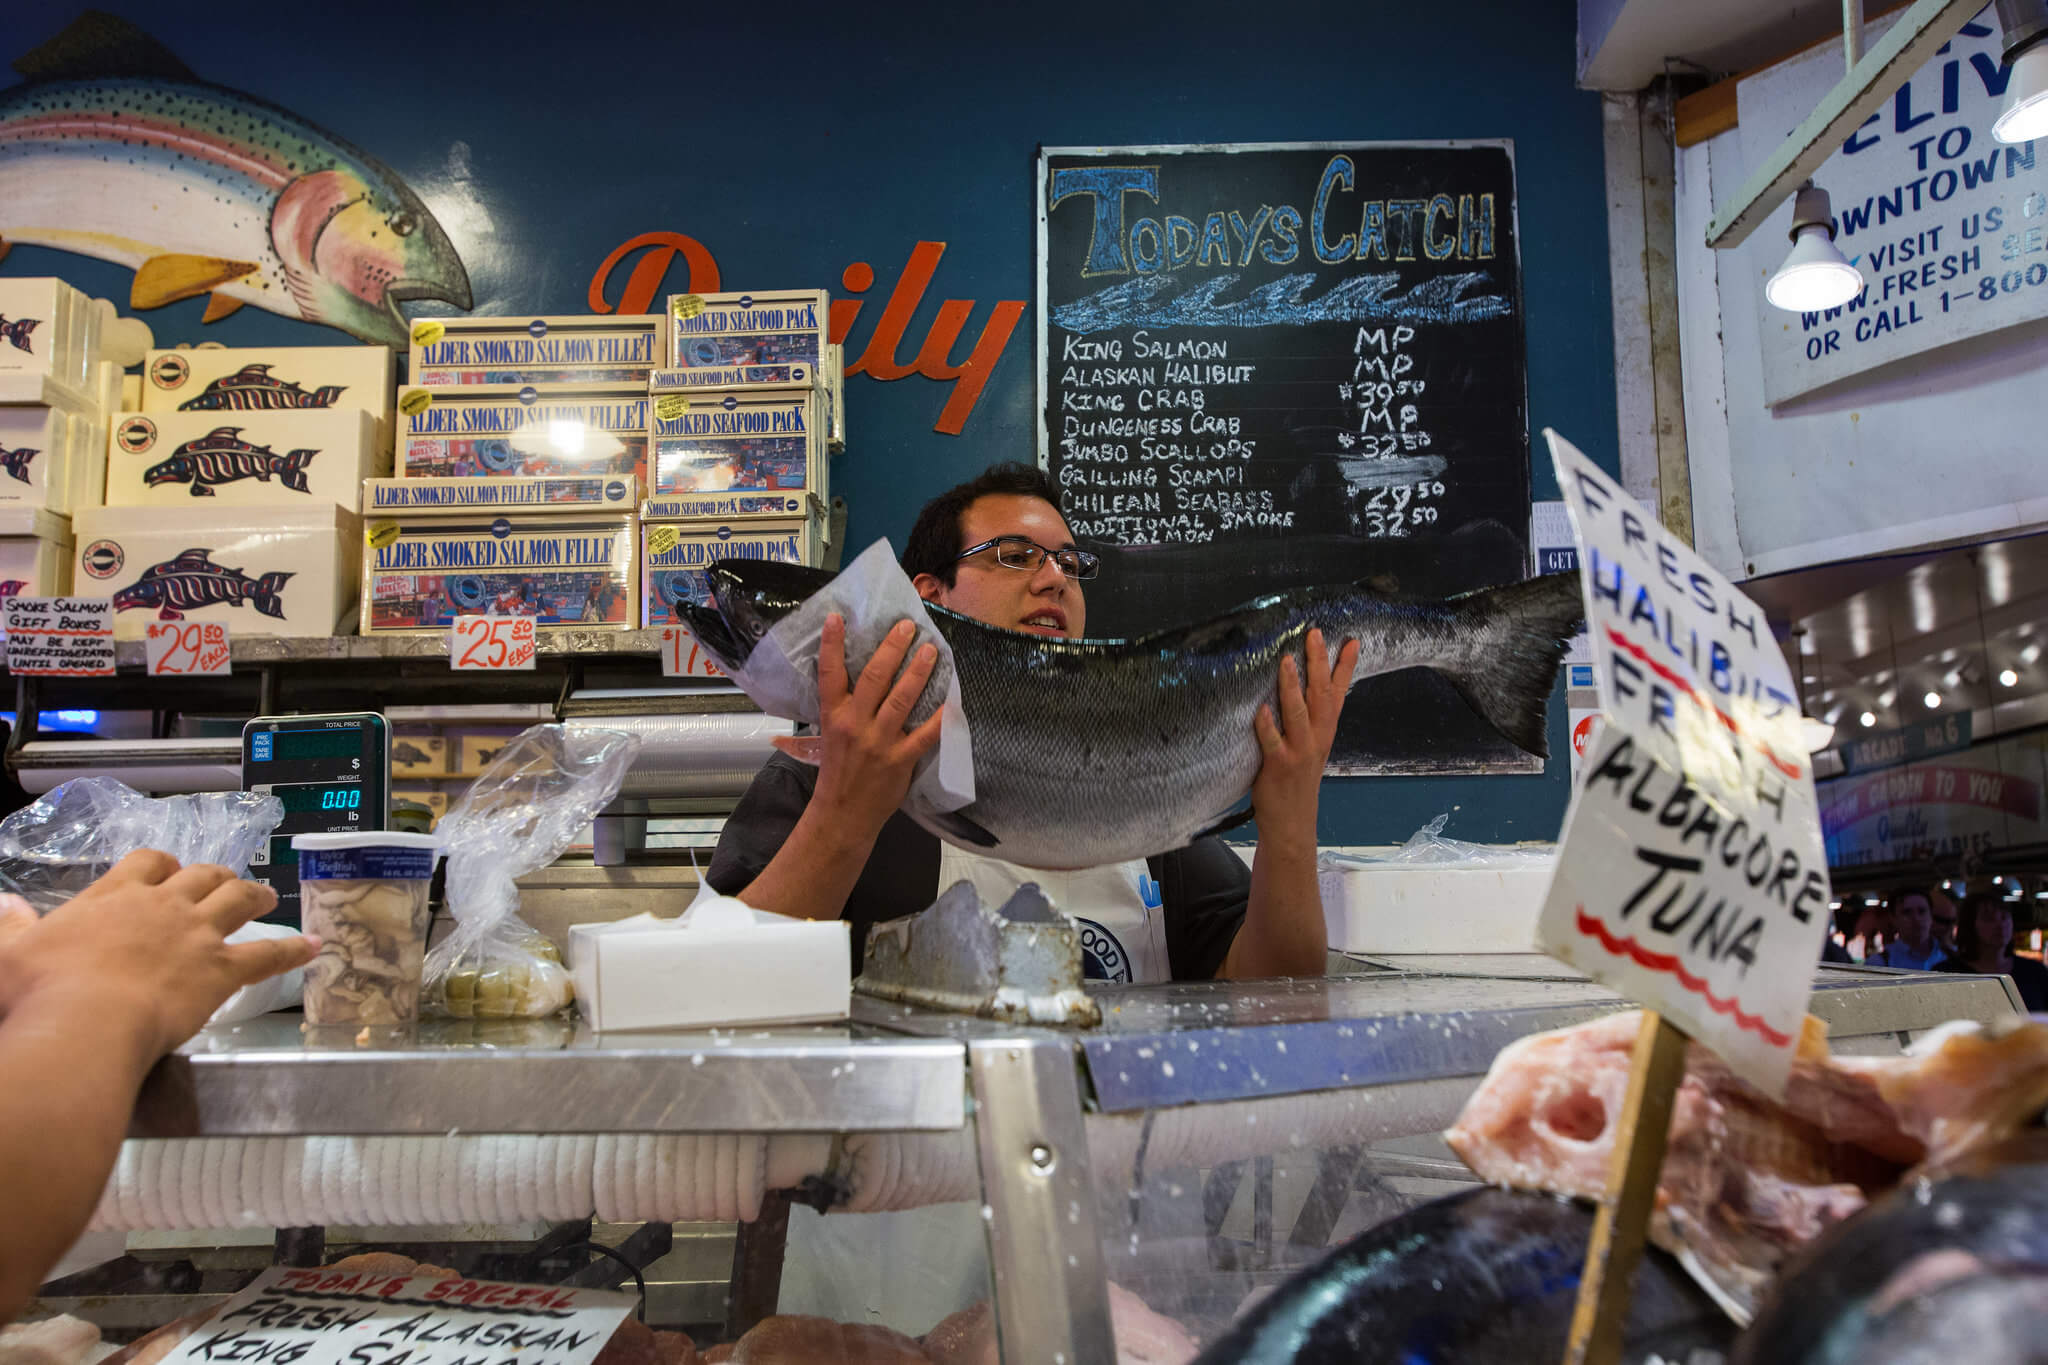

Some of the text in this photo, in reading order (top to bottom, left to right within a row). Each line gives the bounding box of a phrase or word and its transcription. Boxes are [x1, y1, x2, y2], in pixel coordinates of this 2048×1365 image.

[1909, 126, 1972, 171] TO
[1832, 140, 2035, 241] WNTOWN
[1048, 154, 1496, 278] TODAYS CATCH
[1869, 225, 1944, 272] VISIT
[1962, 206, 2003, 240] US
[2001, 226, 2048, 262] SE
[588, 231, 1028, 435] Dily
[678, 304, 818, 333] SMOKED SEAFOOD PACK
[1806, 330, 1840, 360] OR
[1856, 301, 1923, 342] CALL
[422, 333, 656, 366] ALDER SMOKED SALMON FILLET
[1063, 330, 1227, 361] KING SALMON
[655, 367, 744, 386] SMOKED SEAFOOD PACK
[1061, 361, 1256, 387] ALASKAN HALIBUT
[1061, 389, 1206, 412] KING CRAB
[408, 407, 458, 433] ALDER
[462, 407, 524, 432] SMOKED
[590, 401, 649, 430] FILLET
[656, 406, 806, 435] SMOKED SEAFOOD PACK
[1063, 410, 1241, 438] DUNGENESS CRAB
[1060, 437, 1257, 463] JUMBO SCALLOPS
[1059, 463, 1244, 487] GRILLING SCAMPI
[374, 482, 545, 505] ALDER SMOKED SALMON FILLET
[647, 498, 738, 516] SMOKED SEAFOOD PACK
[1060, 487, 1273, 514] CHILEAN SEABASS
[1066, 511, 1296, 536] RADITIONAL SMOKE
[1116, 529, 1214, 546] SALMON
[374, 538, 616, 568] ALDER SMOKED SALMON FILLE
[649, 535, 800, 565] SMOKED SEAFOOD PACK
[1548, 551, 1574, 569] GET
[1574, 468, 1758, 648] FRESH
[6, 597, 108, 613] SMOKE SALMON
[9, 616, 102, 631] GIFT BOXES
[9, 636, 105, 648] MAY BE KEPT
[12, 658, 106, 669] UNTIL OPENED
[201, 643, 229, 672] EACH
[325, 721, 343, 729] TOTAL
[1610, 651, 1787, 822] FRH
[351, 758, 360, 769] $
[322, 790, 361, 809] 0.00
[348, 811, 359, 821] lb
[1584, 735, 1826, 924] ALBACORE
[255, 852, 265, 862] lb
[1620, 847, 1765, 980] TUNA
[1082, 929, 1119, 968] OOD
[423, 1279, 582, 1309] SPECIAL
[220, 1299, 378, 1333] FRESH
[379, 1311, 600, 1353] ALASKAN
[188, 1328, 317, 1365] KING
